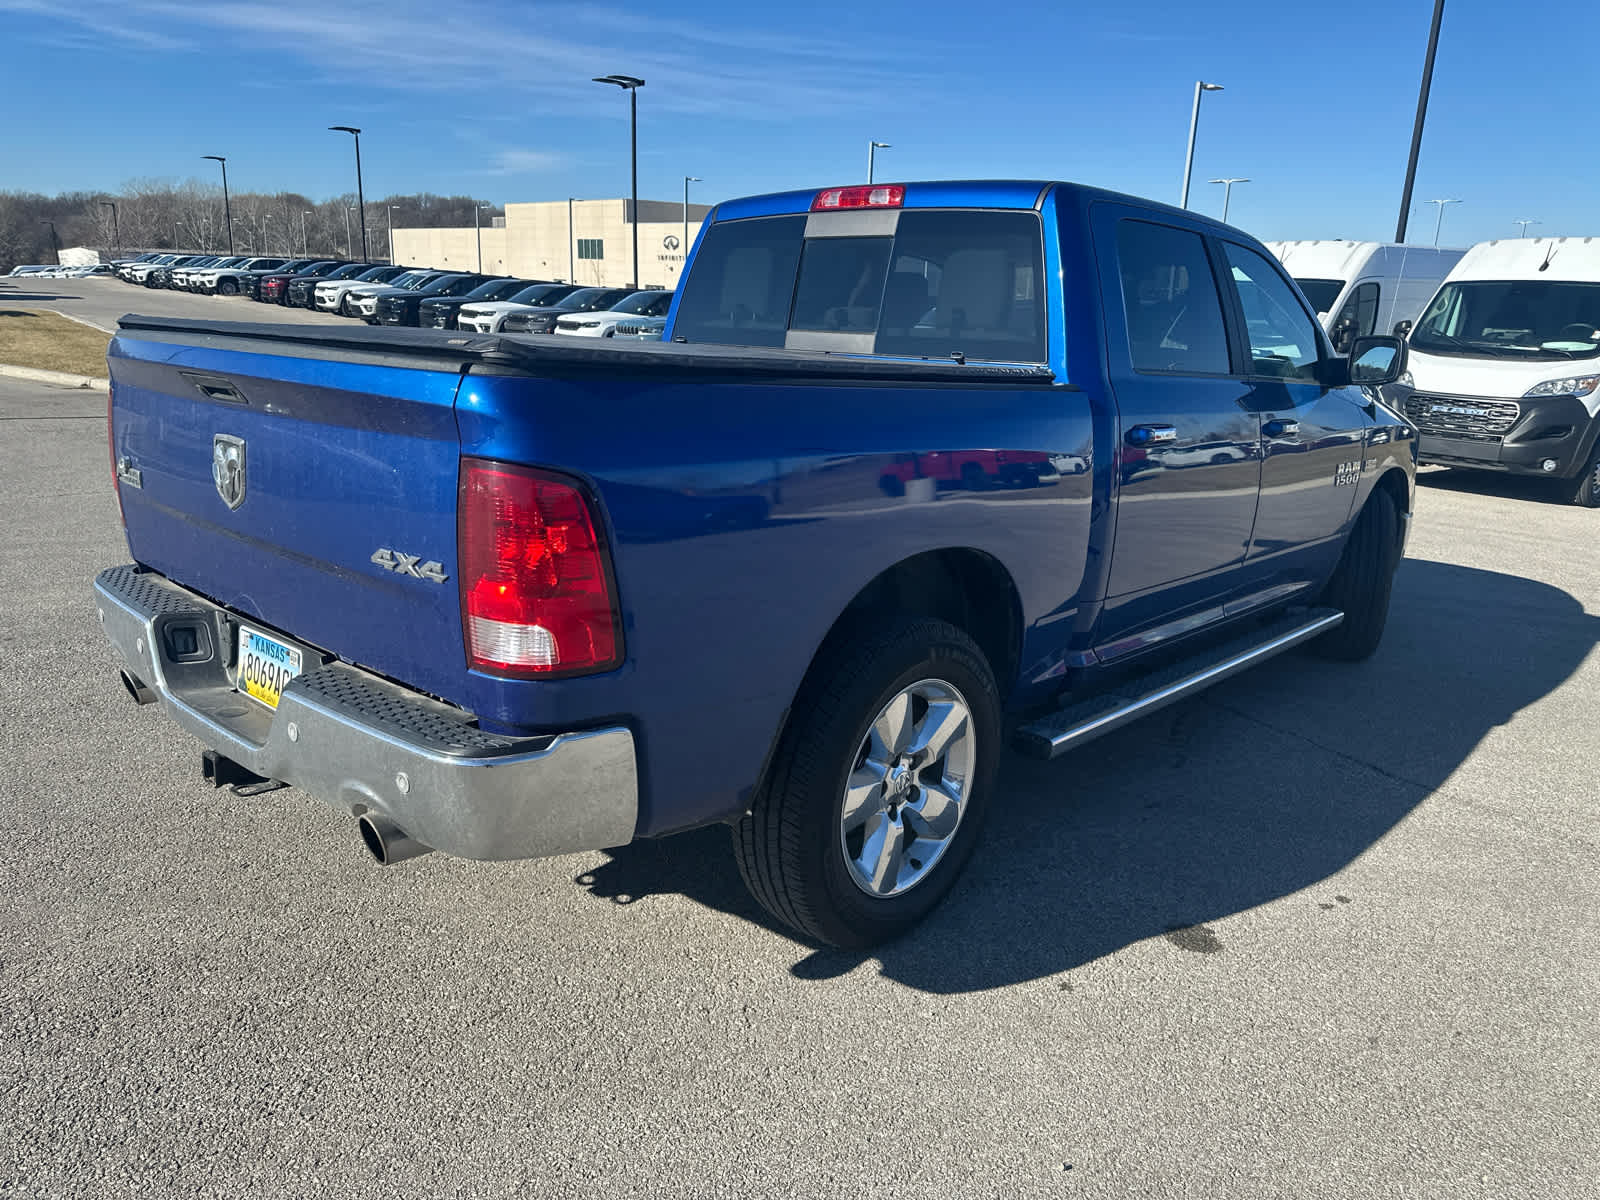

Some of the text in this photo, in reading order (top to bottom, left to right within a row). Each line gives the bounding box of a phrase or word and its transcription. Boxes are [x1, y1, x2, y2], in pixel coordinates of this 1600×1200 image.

[1336, 461, 1361, 474] RAM
[1335, 473, 1360, 487] 1500
[255, 636, 285, 663] KANSAS
[246, 652, 293, 697] 8069AC
